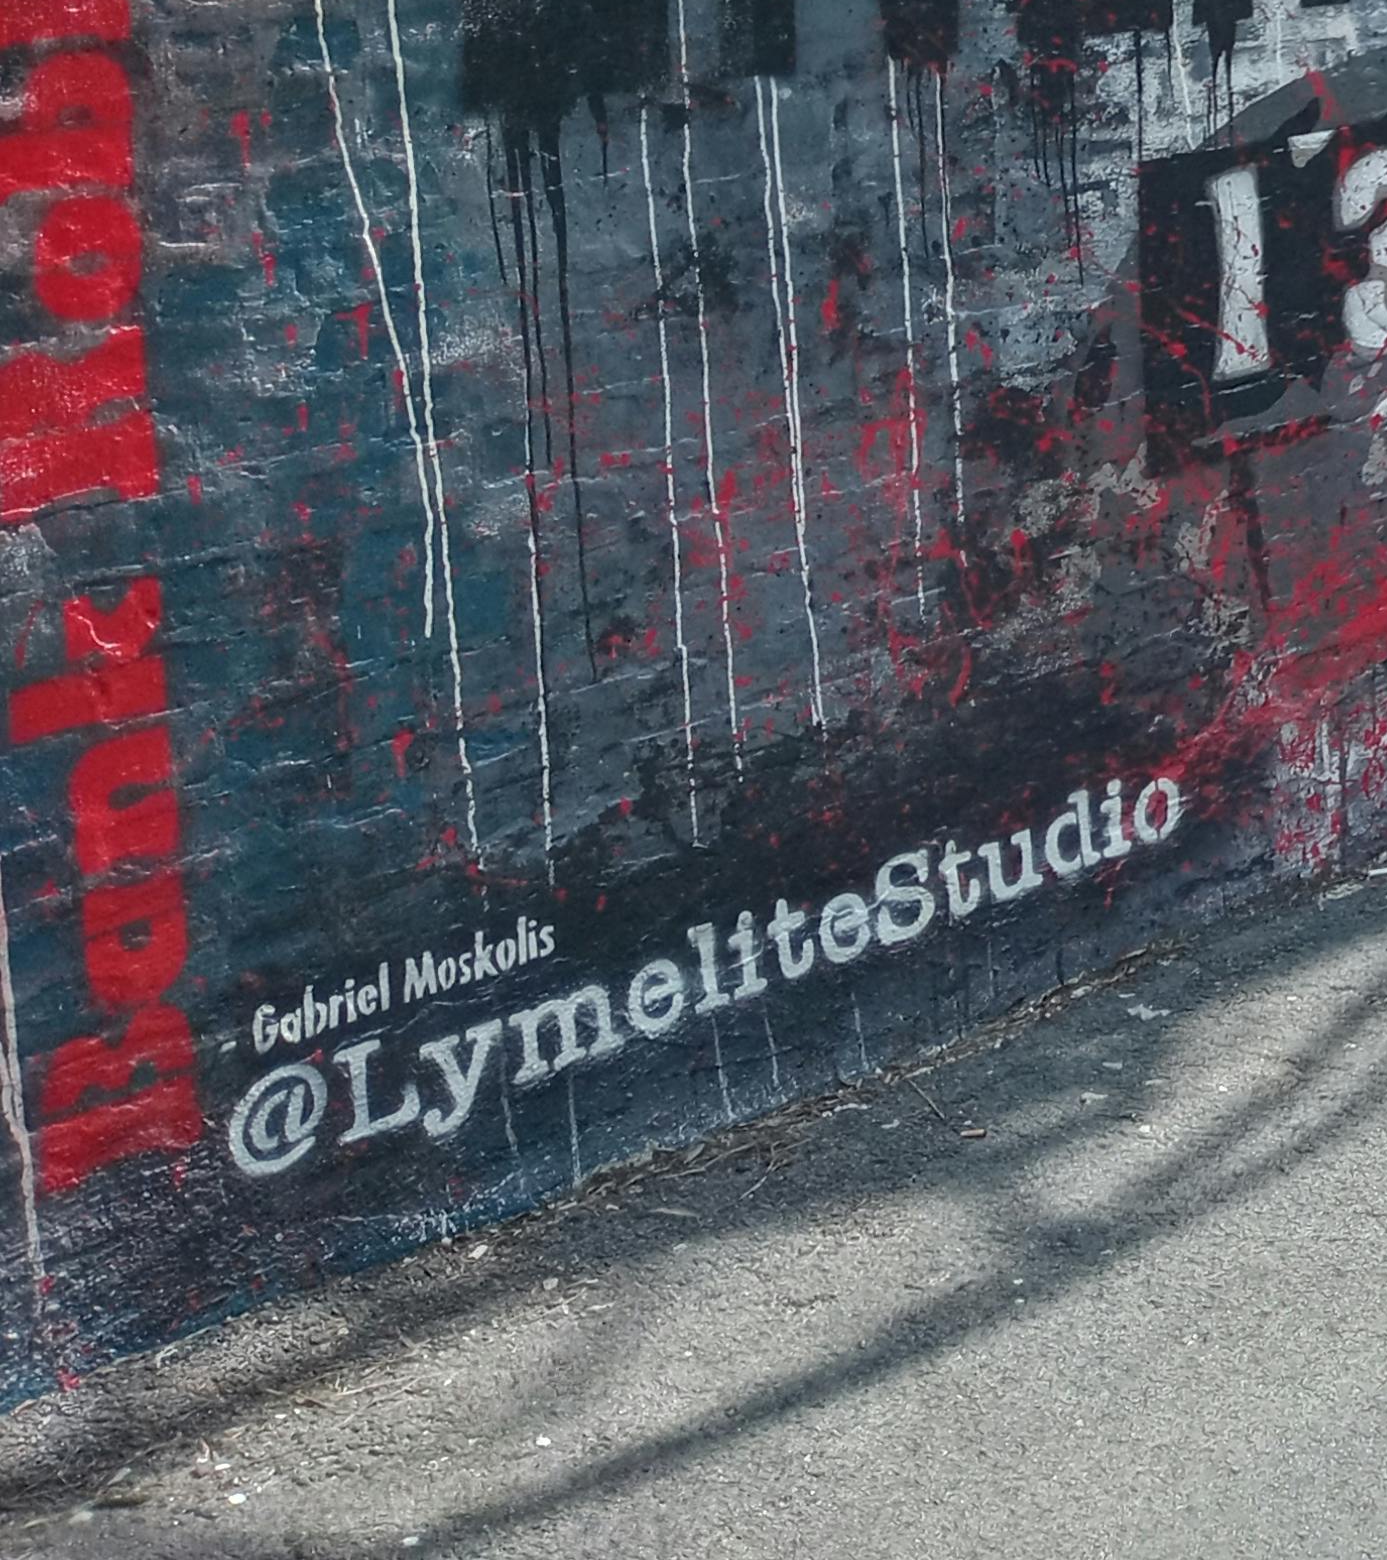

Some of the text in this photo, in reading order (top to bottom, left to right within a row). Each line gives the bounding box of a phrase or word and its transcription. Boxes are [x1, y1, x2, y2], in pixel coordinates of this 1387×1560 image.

[226, 775, 1186, 1178] @LymeliteStudio
[253, 962, 391, 1054] Gabriel
[403, 915, 556, 1004] Moskolis
